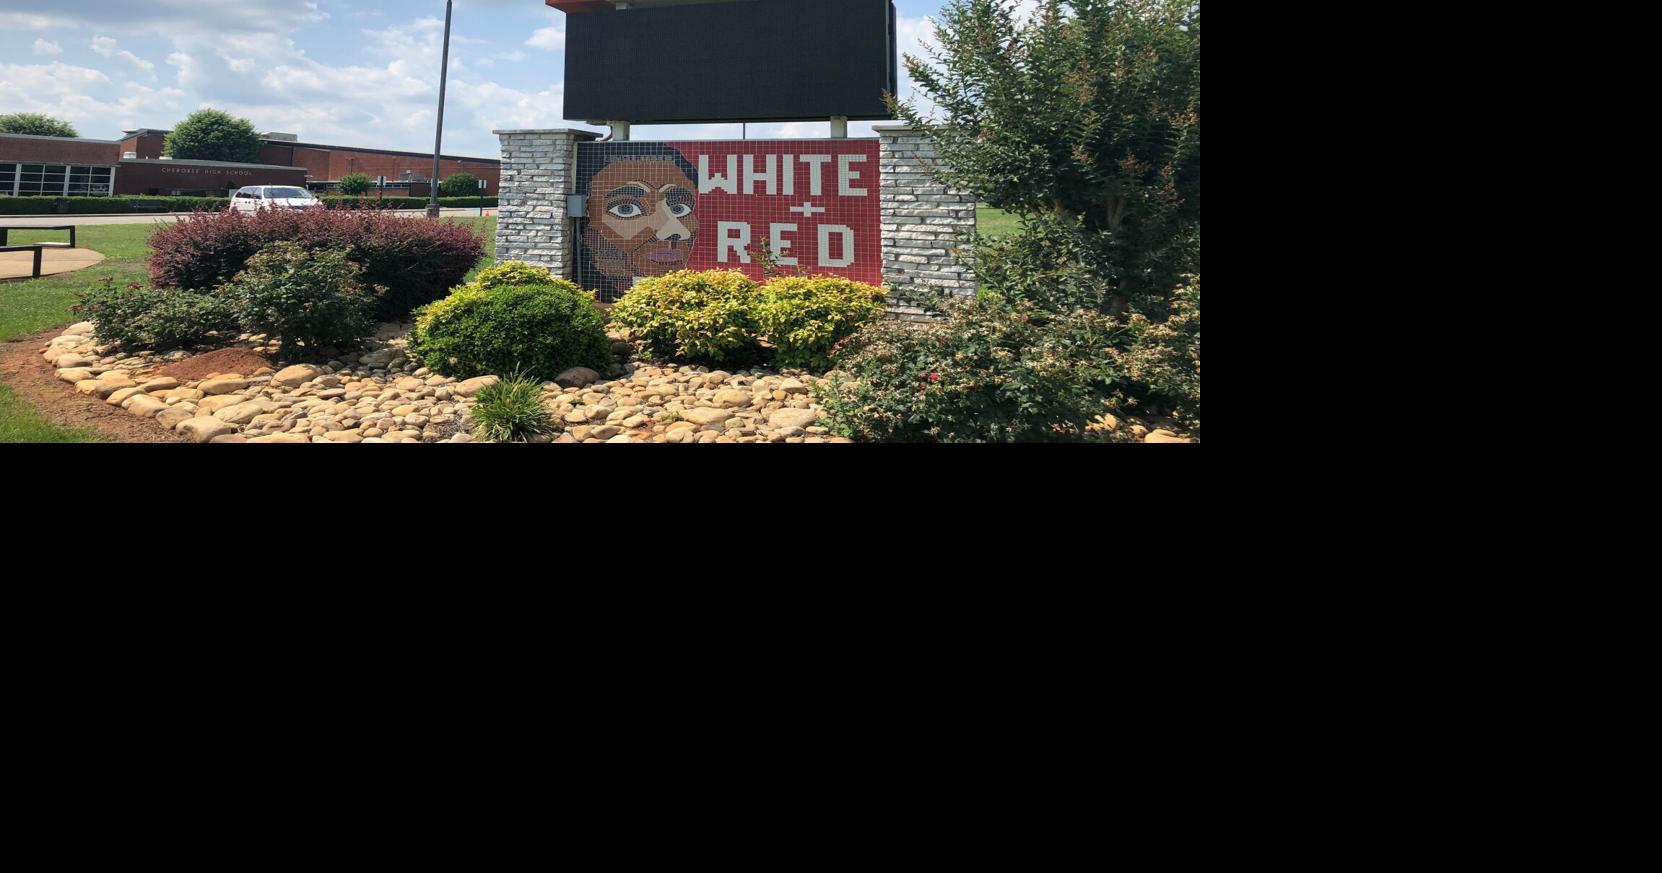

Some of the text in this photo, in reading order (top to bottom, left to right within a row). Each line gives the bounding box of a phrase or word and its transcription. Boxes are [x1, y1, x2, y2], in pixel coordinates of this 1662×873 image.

[698, 154, 868, 197] WHITE
[790, 202, 825, 217] +
[717, 221, 855, 268] RED
